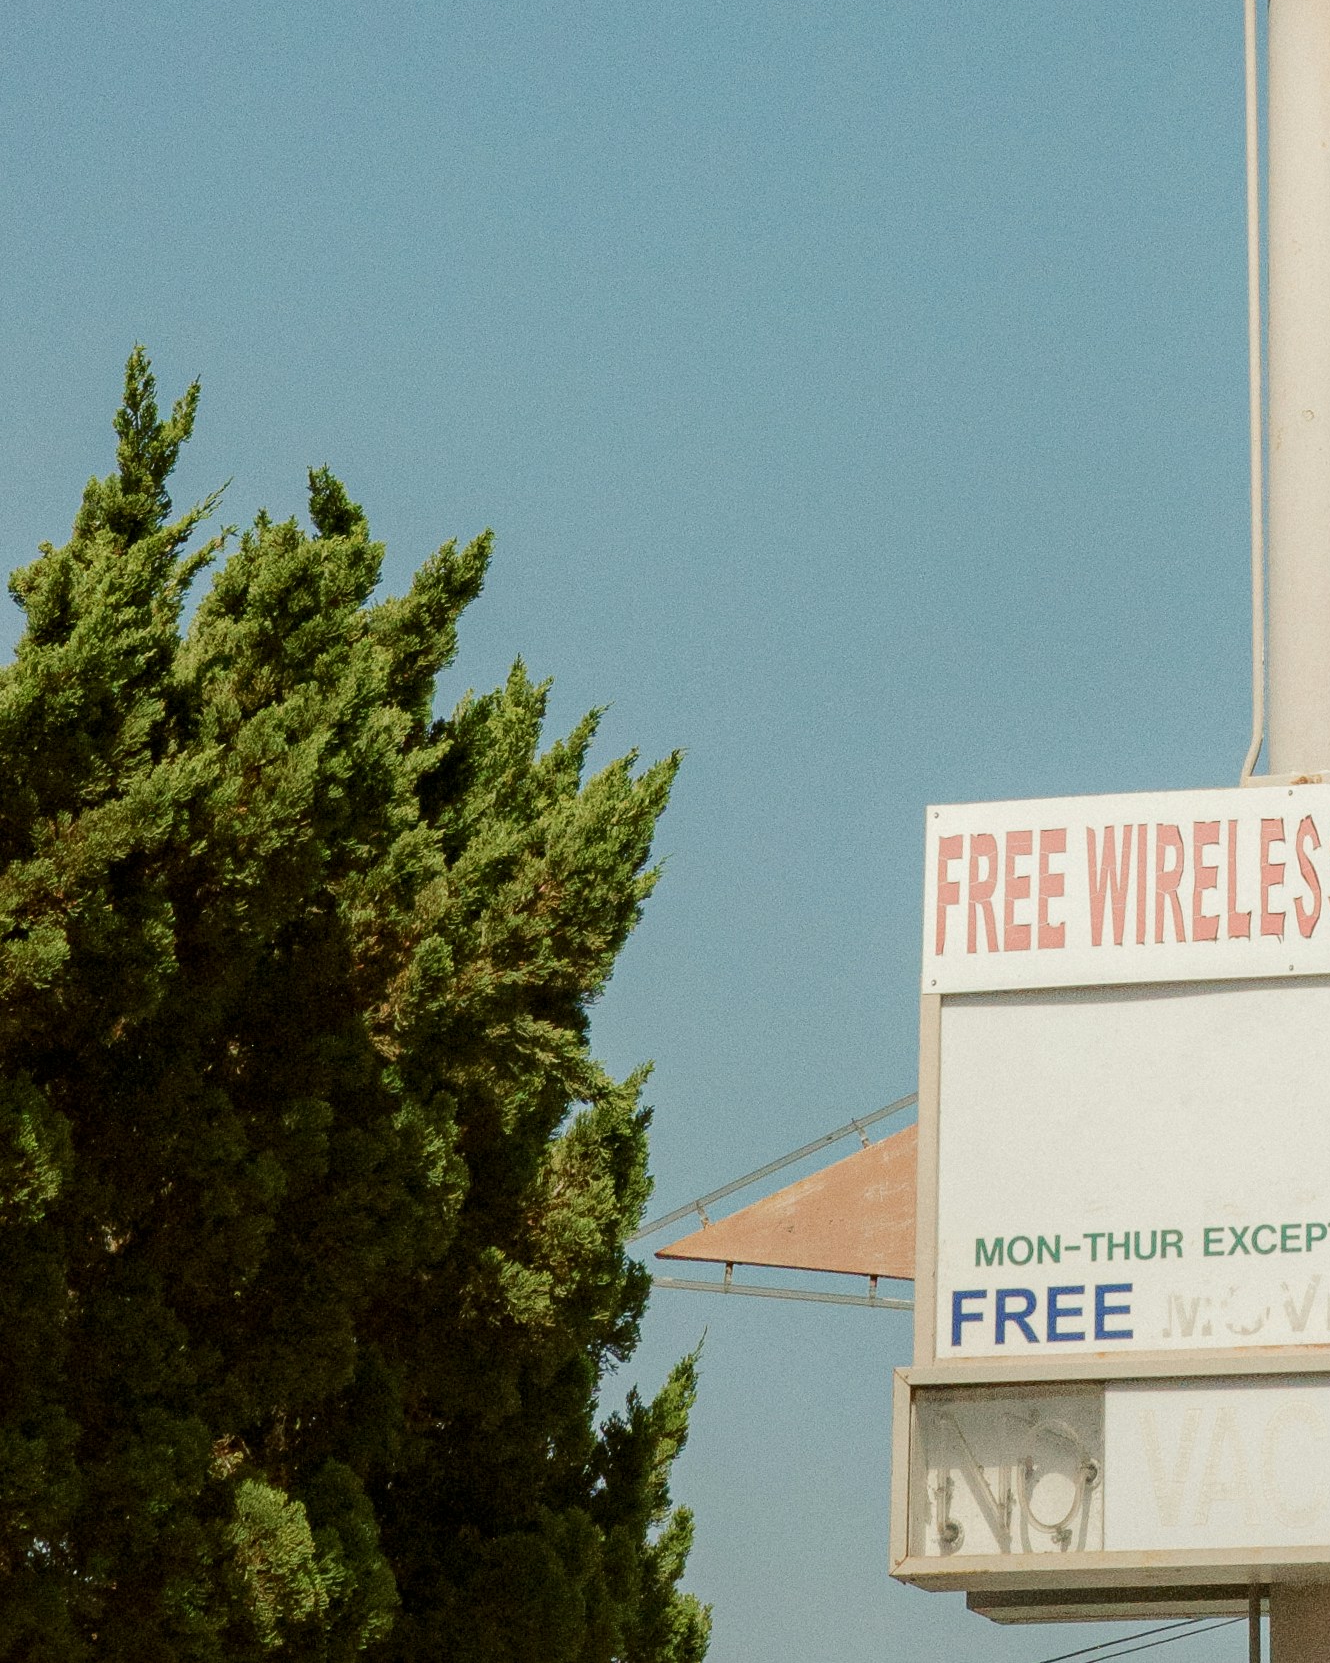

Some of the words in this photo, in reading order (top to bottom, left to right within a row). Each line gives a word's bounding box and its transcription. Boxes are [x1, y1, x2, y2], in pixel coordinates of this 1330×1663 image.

[935, 828, 1067, 956] FREE
[975, 1230, 1183, 1267] MON-THUR
[951, 1283, 1134, 1347] FREE
